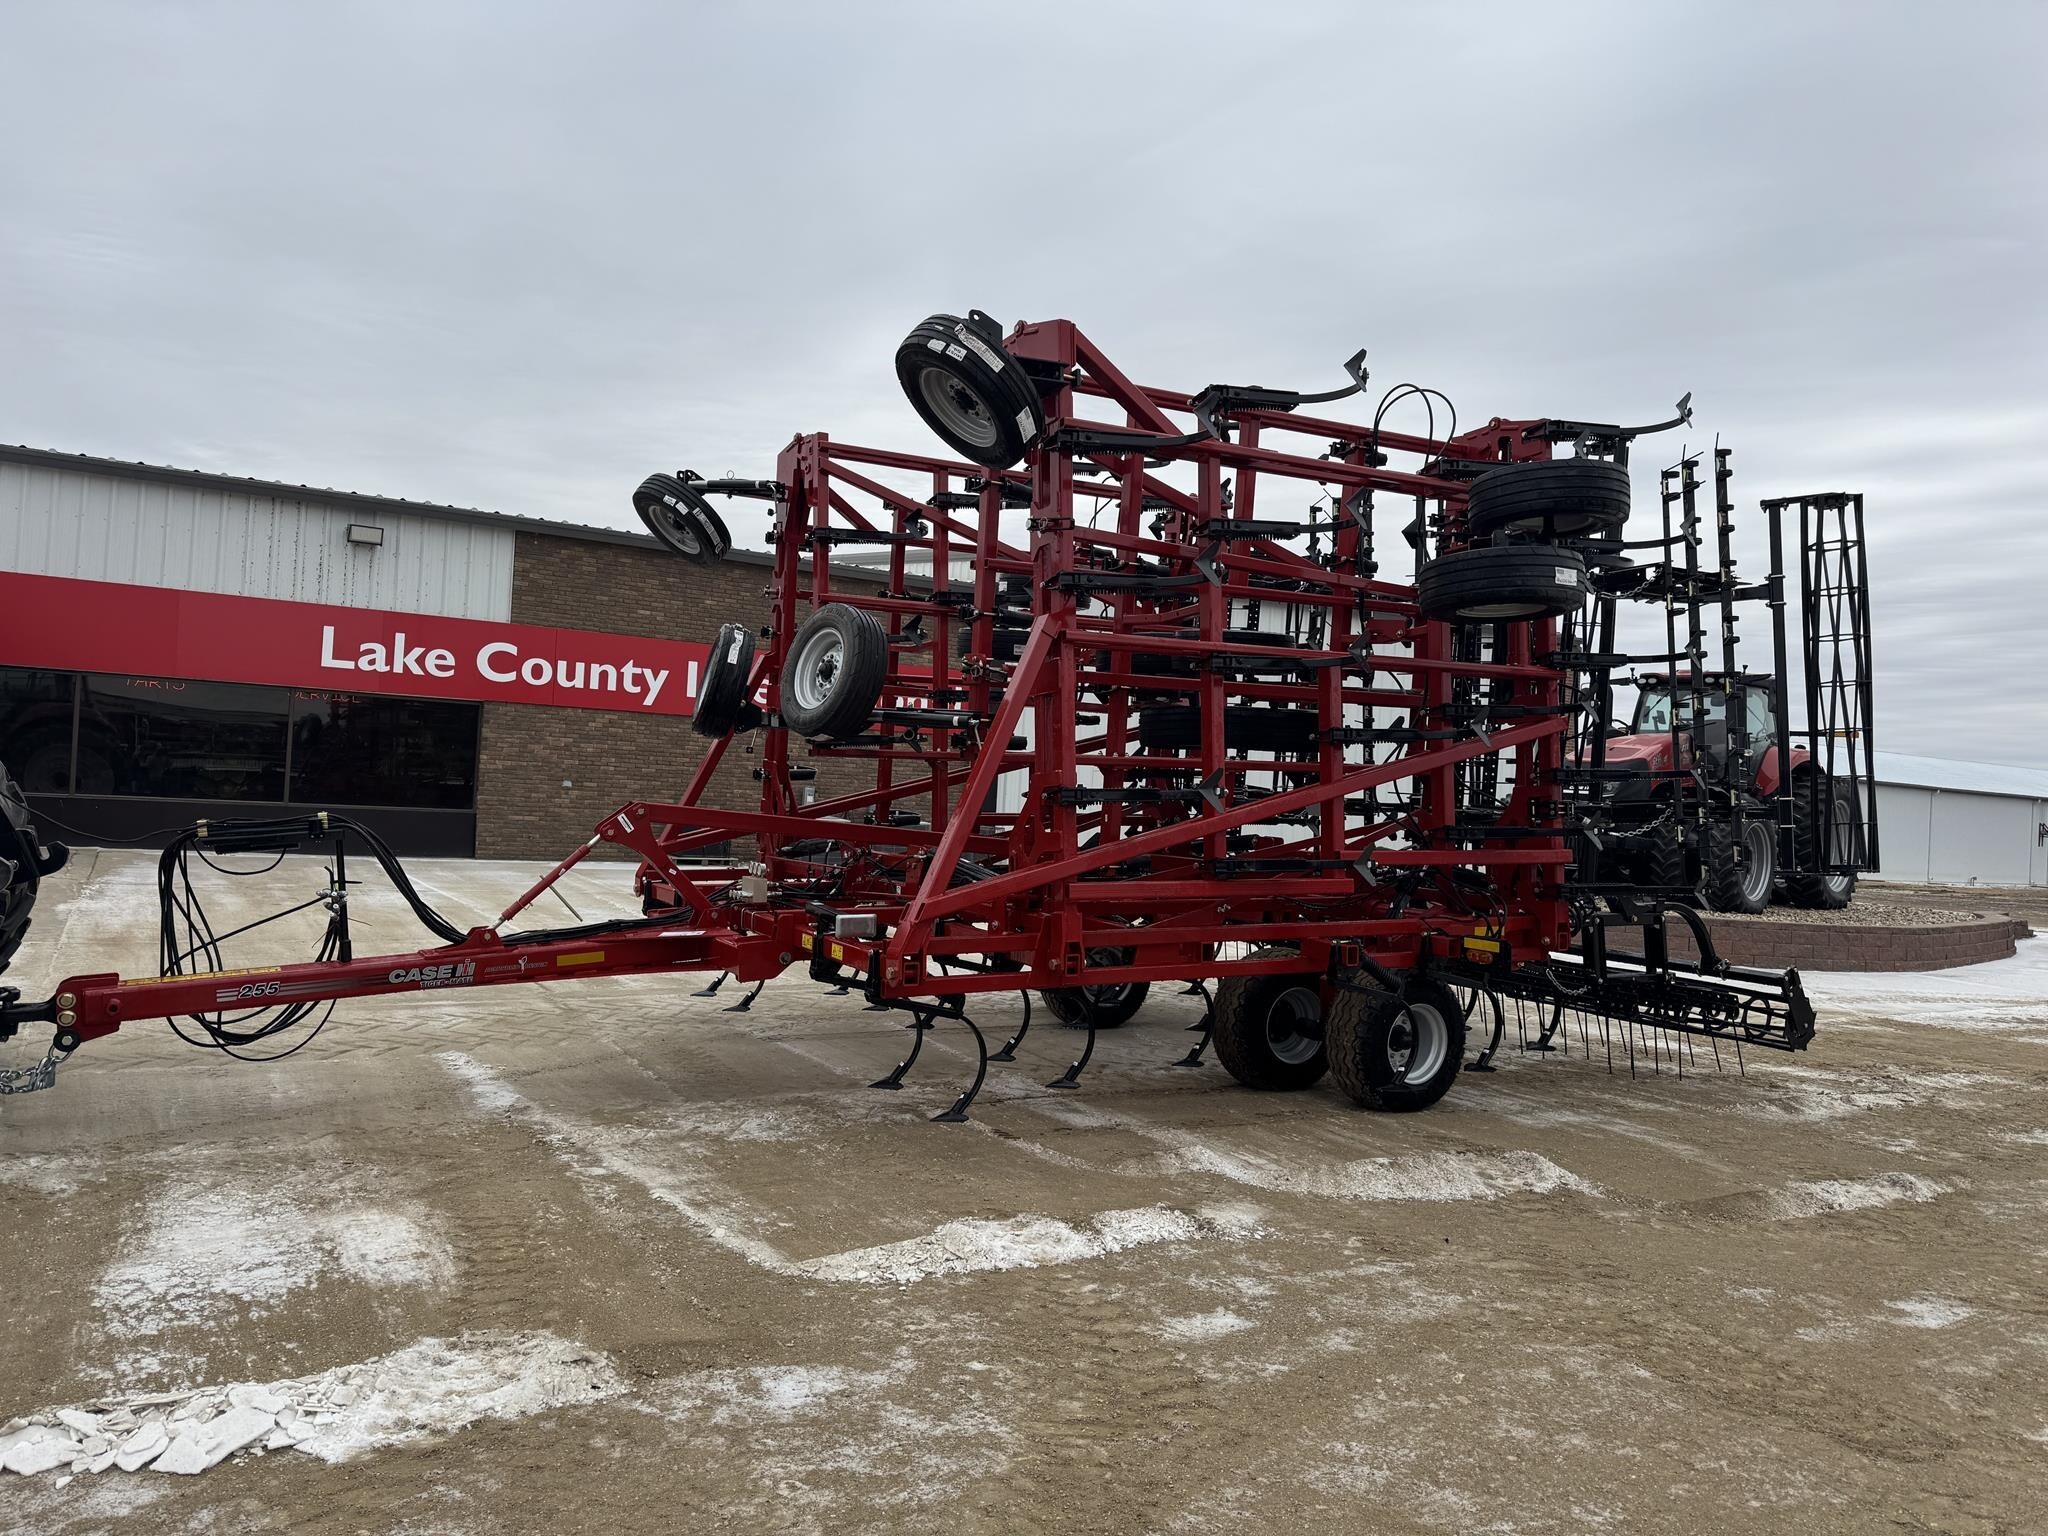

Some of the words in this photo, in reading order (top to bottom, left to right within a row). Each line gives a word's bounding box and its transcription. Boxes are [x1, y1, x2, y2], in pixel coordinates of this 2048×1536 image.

[320, 625, 456, 678] Lake
[476, 642, 670, 706] County
[388, 964, 452, 984] CASE
[238, 981, 281, 999] 255
